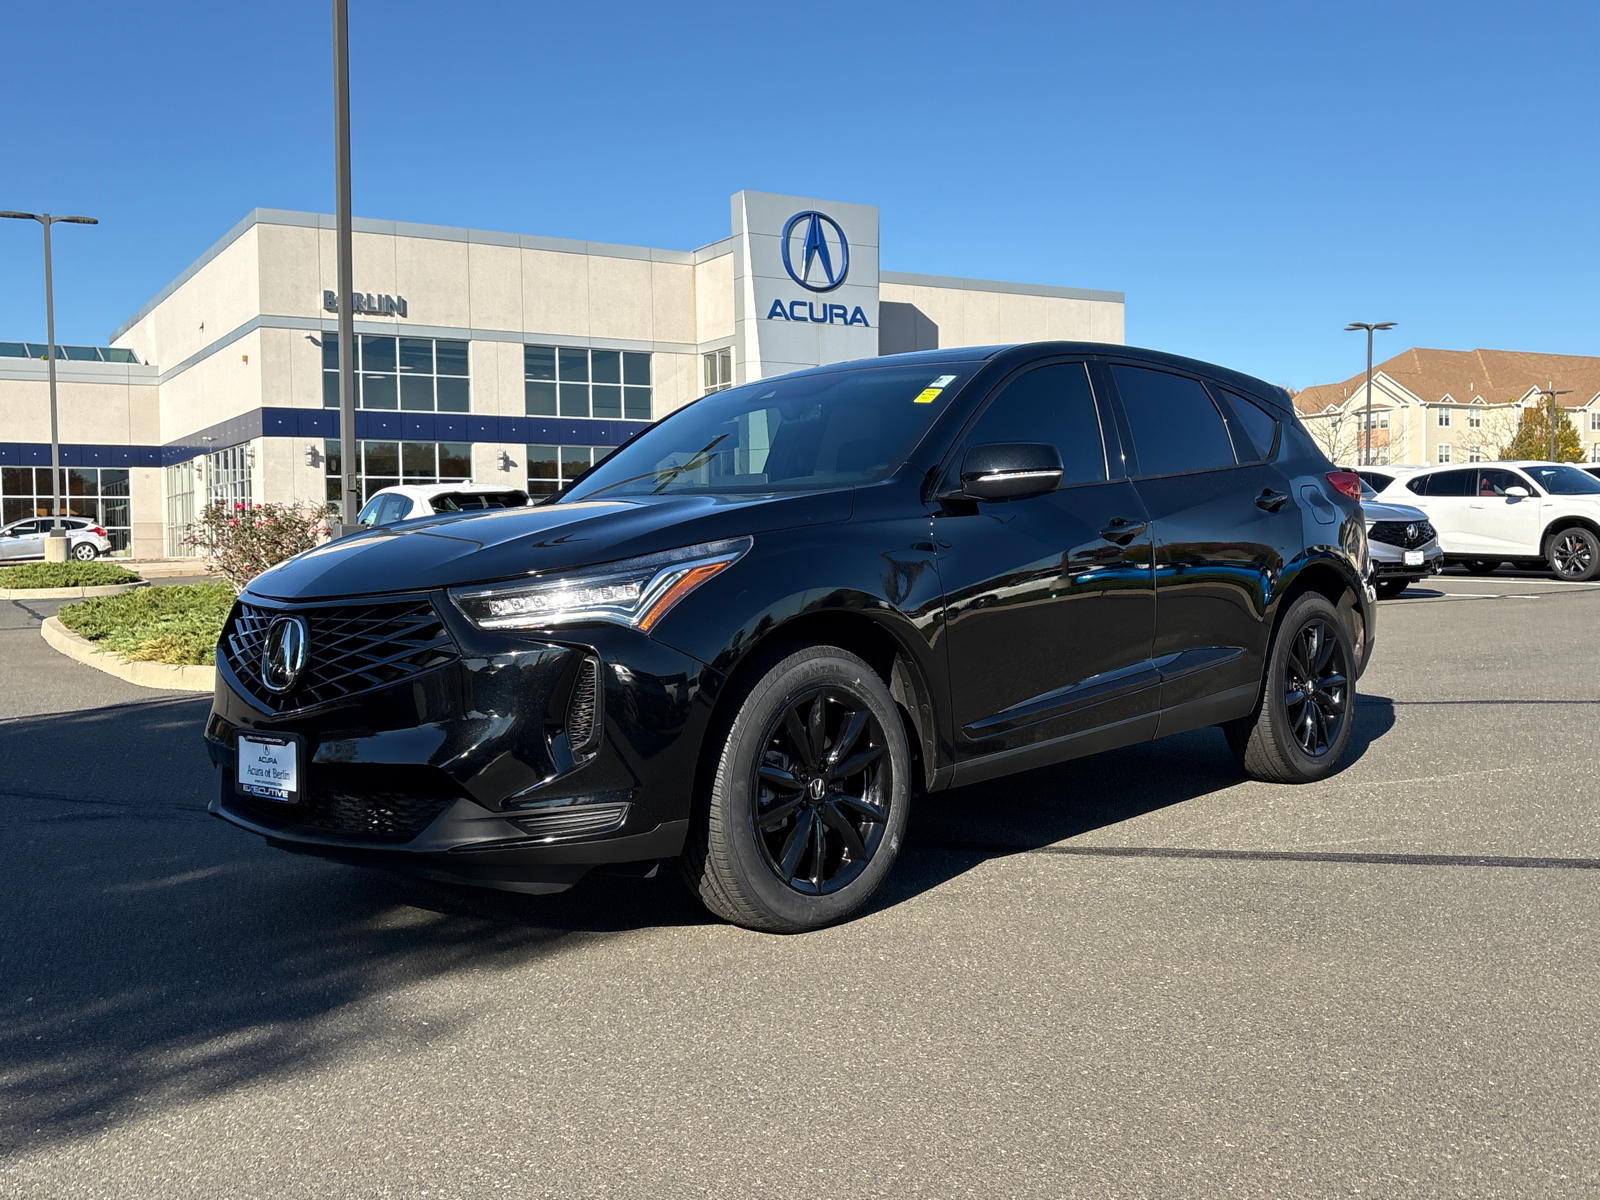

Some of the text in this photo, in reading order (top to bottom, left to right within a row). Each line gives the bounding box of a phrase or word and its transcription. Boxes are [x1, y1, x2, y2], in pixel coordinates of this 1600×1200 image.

[323, 289, 404, 314] BRLIN
[767, 298, 869, 327] ACURA
[258, 756, 278, 765] ACURA
[247, 765, 290, 780] Acura of Berlin
[243, 783, 288, 798] EXECUTIVE
